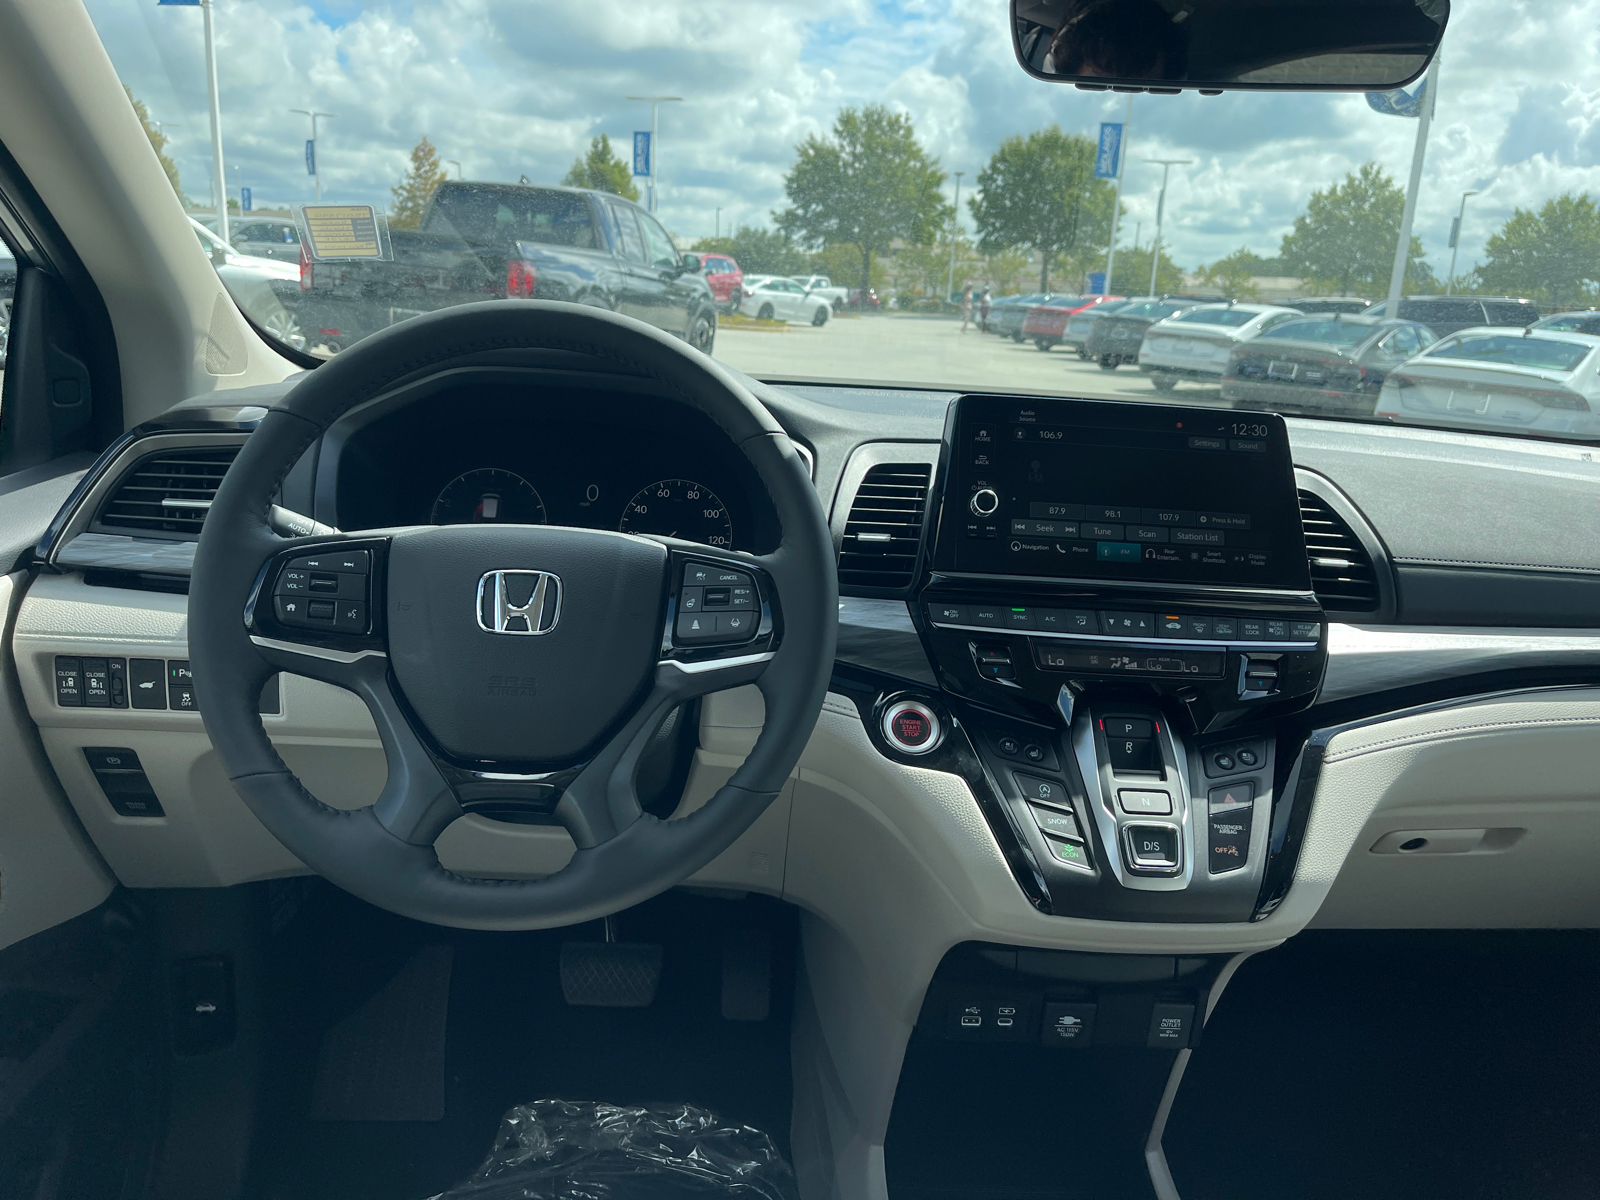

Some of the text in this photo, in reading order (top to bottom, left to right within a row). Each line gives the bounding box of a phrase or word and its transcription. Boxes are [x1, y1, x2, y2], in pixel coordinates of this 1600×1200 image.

[1231, 423, 1268, 437] 12:30
[1039, 430, 1063, 440] 106.9
[1194, 440, 1220, 448] Settings
[1238, 442, 1258, 450] Sound
[586, 484, 599, 501] 0
[657, 489, 670, 498] 60
[687, 491, 700, 500] 80
[634, 505, 647, 514] 40
[703, 509, 719, 518] 100
[1049, 507, 1066, 515] 87.9
[1104, 510, 1121, 518] 98.1
[297, 518, 308, 526] OFF
[1158, 514, 1180, 522] 107.9
[288, 522, 306, 534] AUTO
[1036, 524, 1055, 533] Seek
[1093, 527, 1112, 536] Tune
[1138, 530, 1157, 538] Scan
[1177, 532, 1218, 542] Station List
[708, 536, 725, 545] 120
[488, 676, 536, 686] SRS
[1125, 724, 1133, 733] P
[1125, 741, 1133, 751] R
[1142, 798, 1150, 806] N
[1143, 840, 1160, 851] D/S
